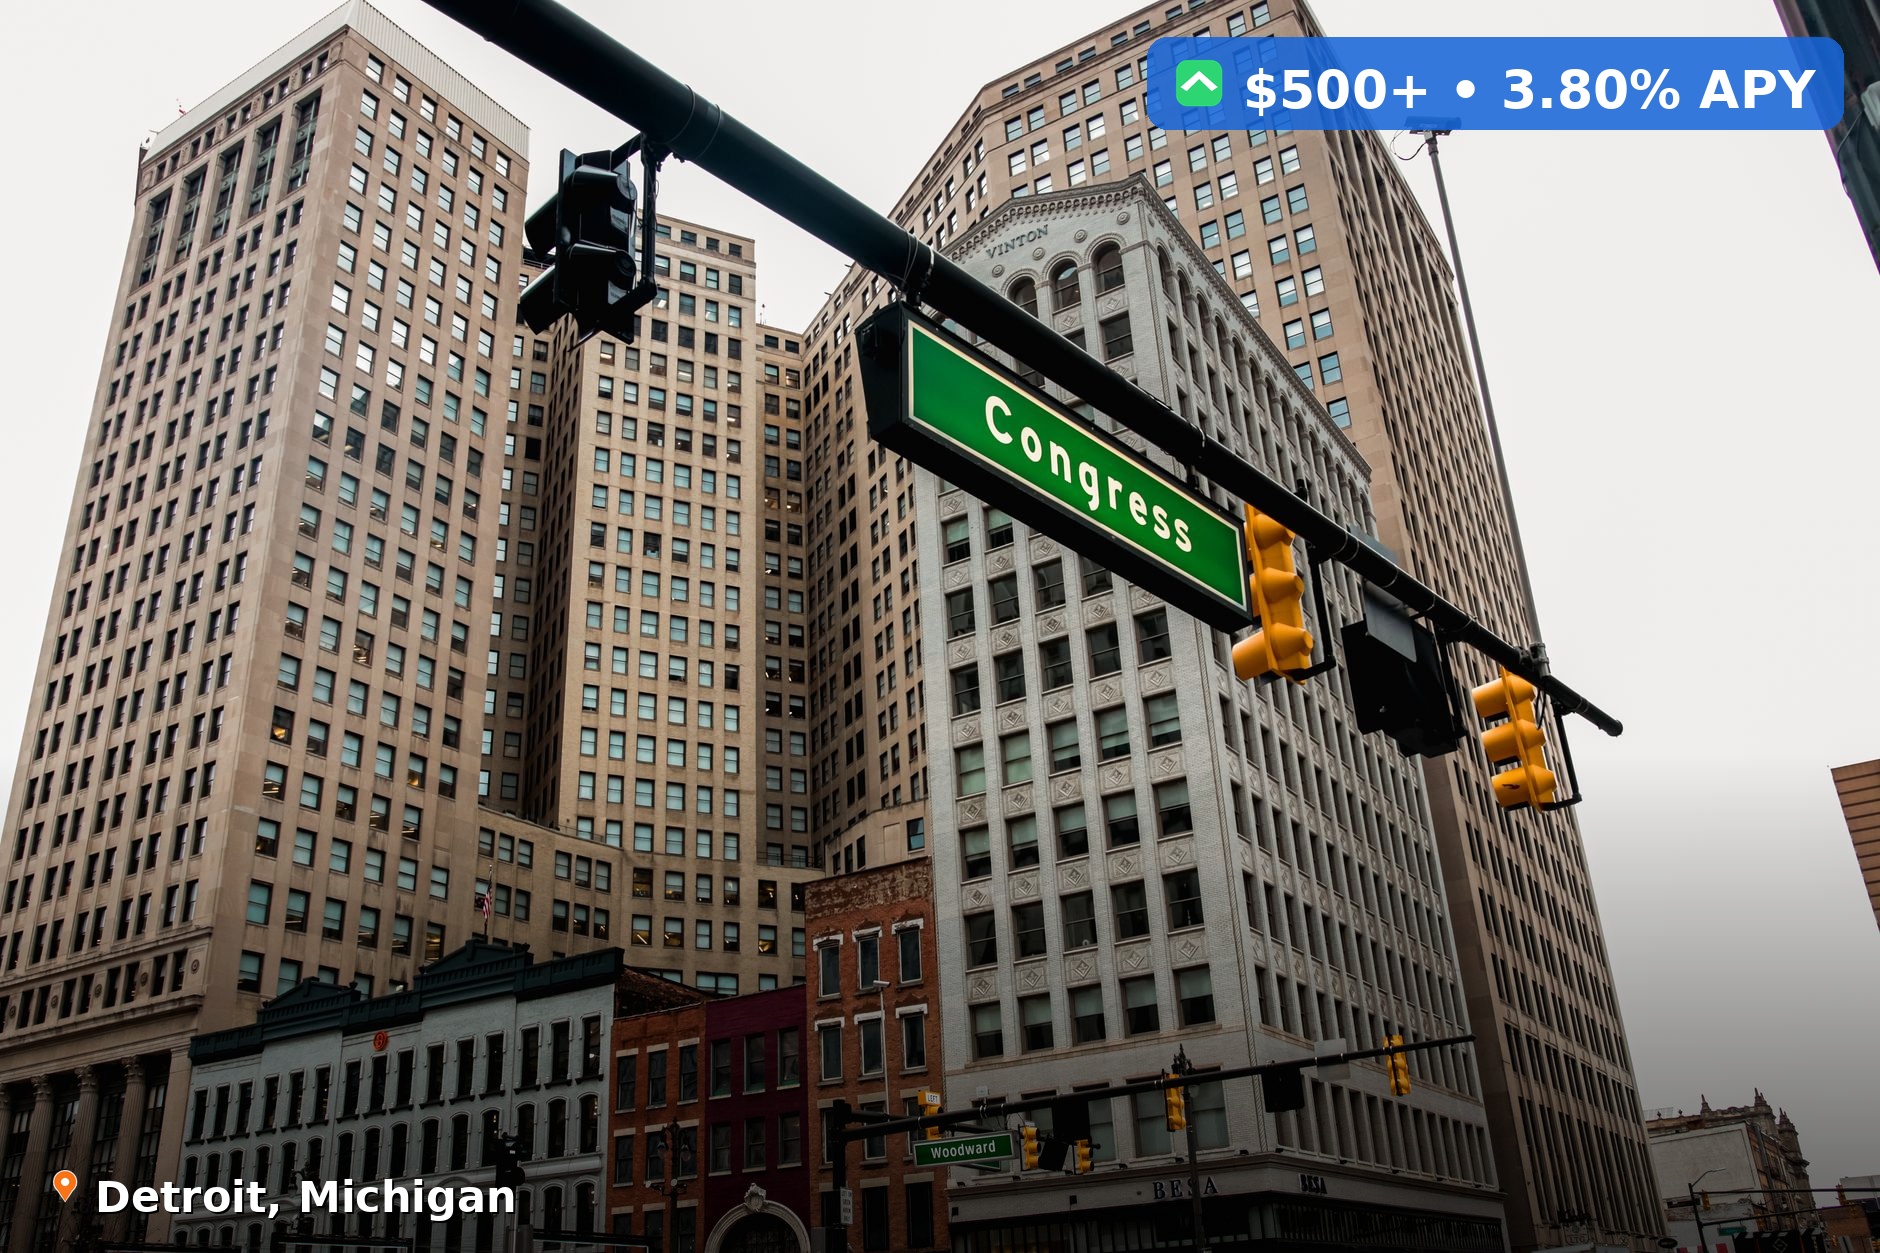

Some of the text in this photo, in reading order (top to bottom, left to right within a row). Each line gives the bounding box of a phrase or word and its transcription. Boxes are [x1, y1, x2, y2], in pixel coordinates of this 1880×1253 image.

[986, 224, 1048, 258] VINTON
[985, 395, 1192, 552] Congress
[927, 1094, 938, 1103] LEFT
[930, 1140, 996, 1159] Woodward
[1300, 1174, 1327, 1194] BESA
